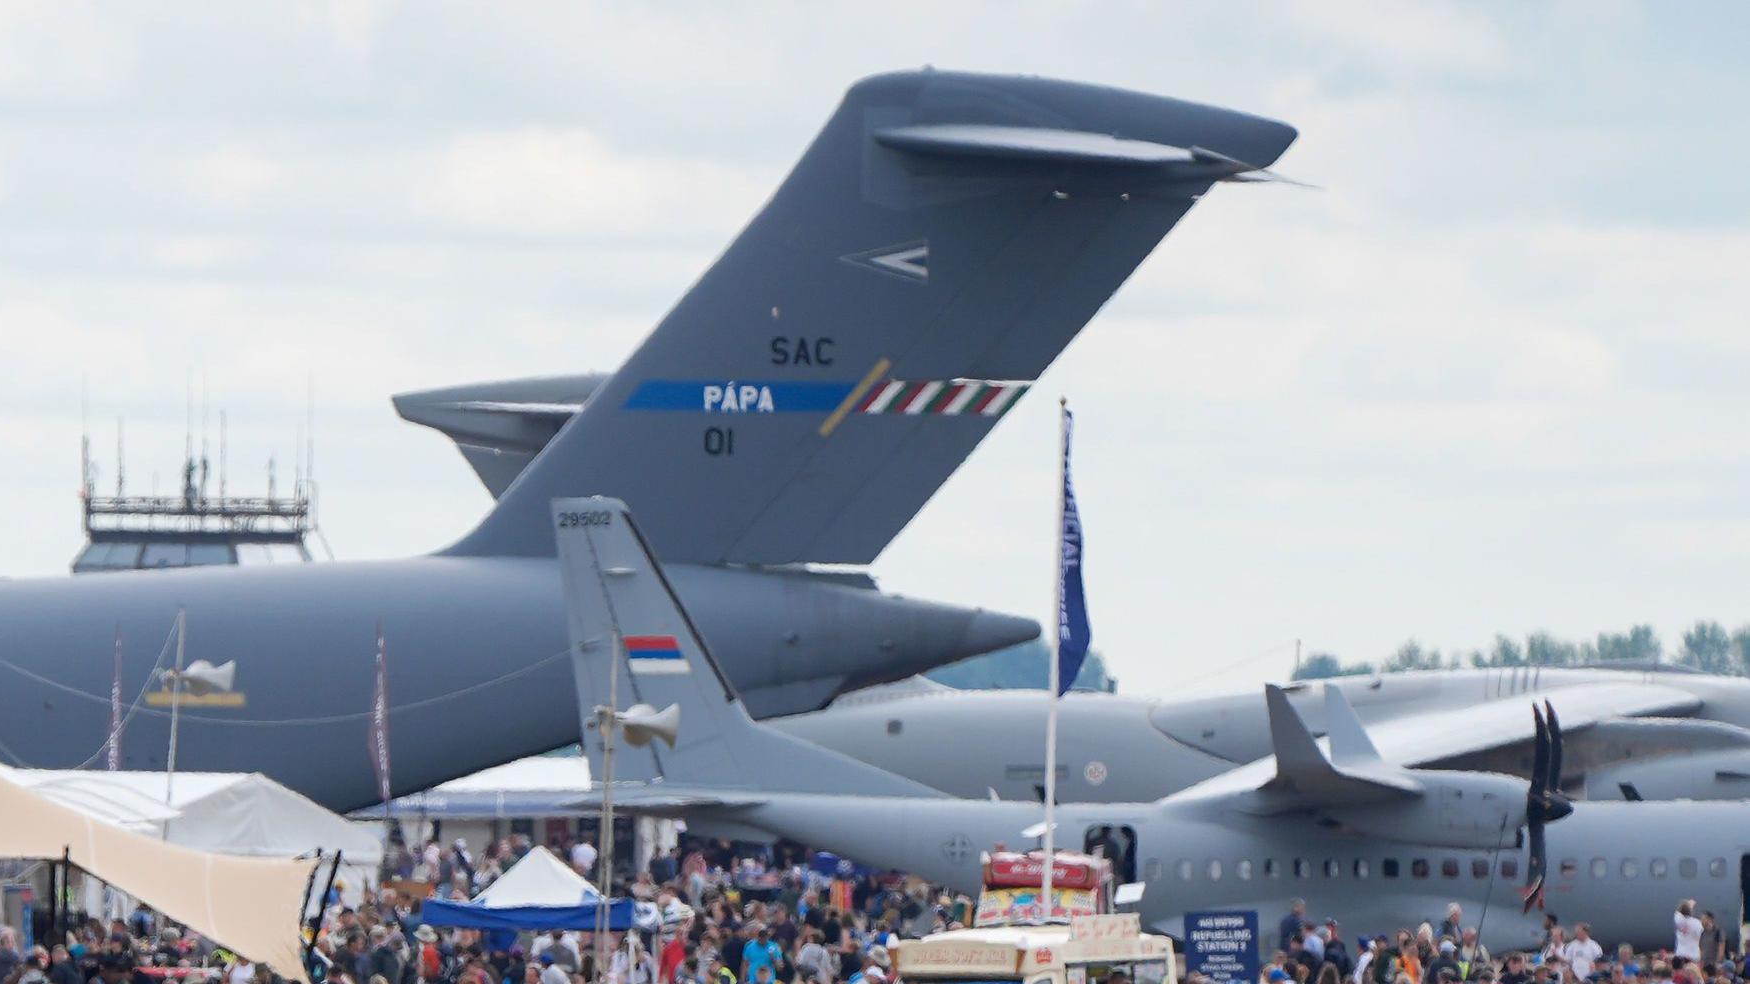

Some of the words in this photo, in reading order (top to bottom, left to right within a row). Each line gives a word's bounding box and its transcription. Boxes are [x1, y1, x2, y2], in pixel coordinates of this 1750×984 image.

[770, 335, 835, 367] SAC
[703, 380, 775, 413] PÁPA
[1196, 941, 1239, 953] STATION
